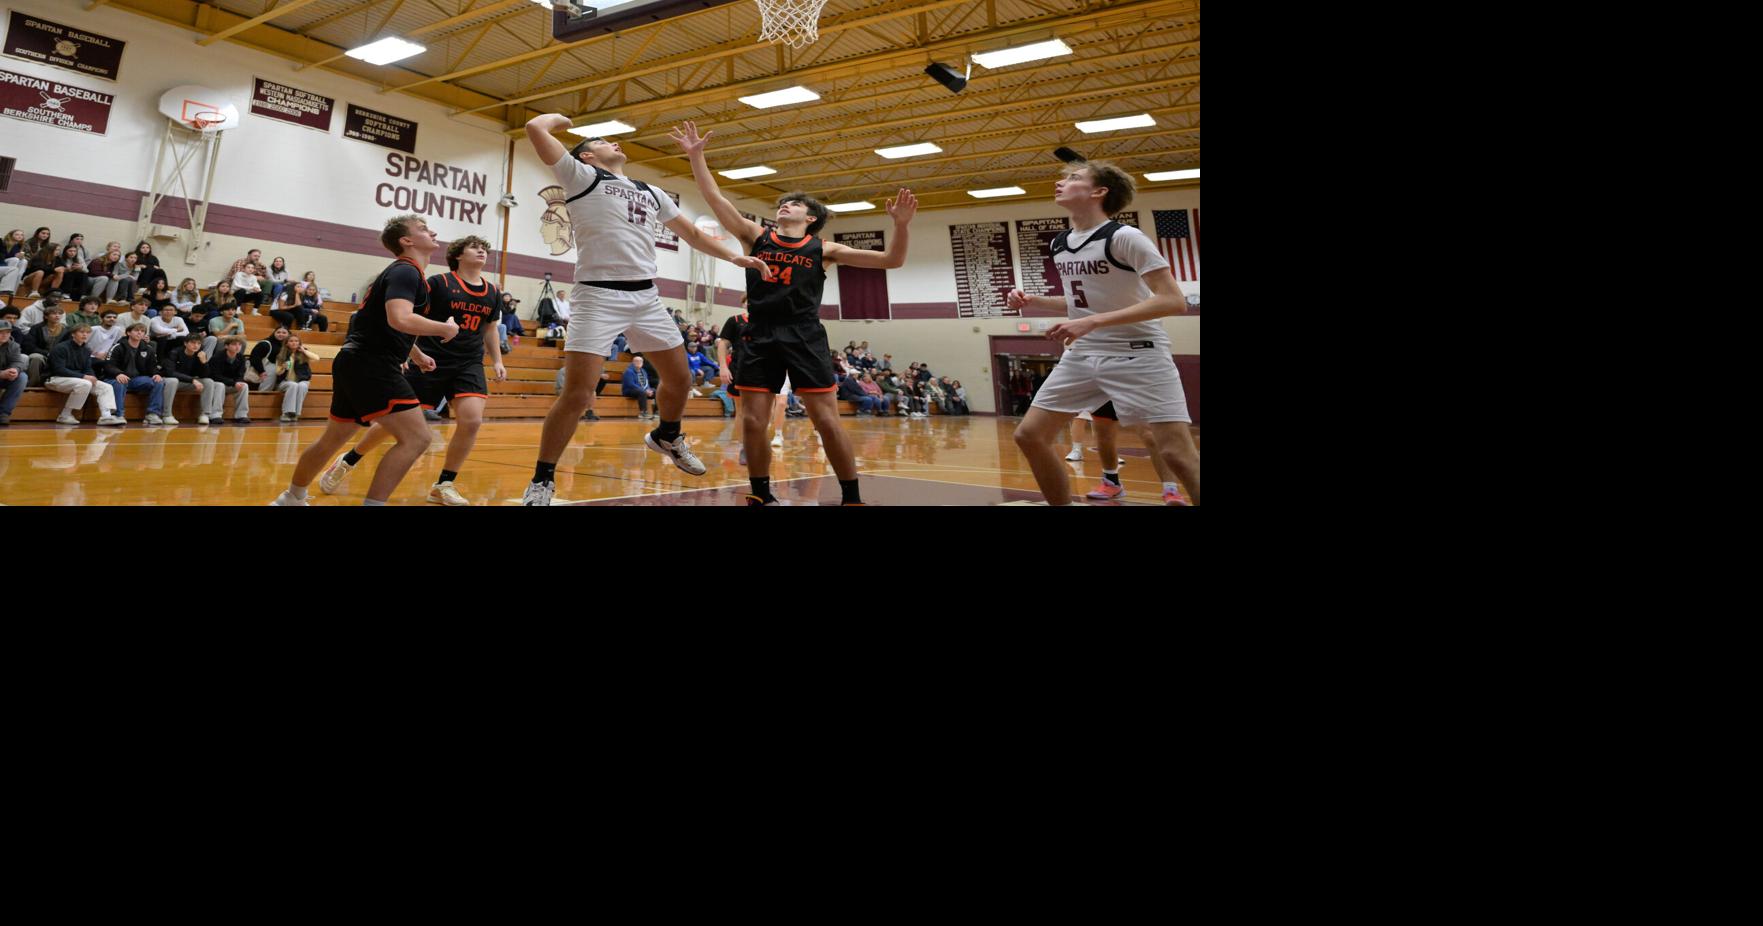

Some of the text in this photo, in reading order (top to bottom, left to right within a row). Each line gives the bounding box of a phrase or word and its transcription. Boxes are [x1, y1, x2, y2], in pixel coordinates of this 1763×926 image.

[24, 19, 111, 48] SPARTAN BASEBALL
[0, 71, 50, 92] SPARTAN
[53, 84, 111, 106] BASEBALL
[259, 87, 285, 100] WESTERN
[263, 81, 327, 105] SPARTAN SOFTBALL
[27, 106, 75, 122] SOUTHERN
[266, 96, 320, 116] CHAMPIONS
[3, 107, 93, 131] BERKSHIRE CHAMPS
[364, 118, 400, 133] SOFTBALL
[361, 124, 401, 141] CHAMPIONS
[385, 152, 487, 197] SPARTAN
[375, 182, 488, 225] COUNTRY
[627, 200, 647, 226] 15
[1022, 218, 1064, 226] SPARTAN
[841, 232, 876, 240] SPARTAN
[756, 251, 813, 269] WILDCATS
[1056, 260, 1110, 276] PARTANS
[766, 265, 793, 286] 24
[1070, 280, 1089, 308] 5
[460, 313, 481, 331] 30
